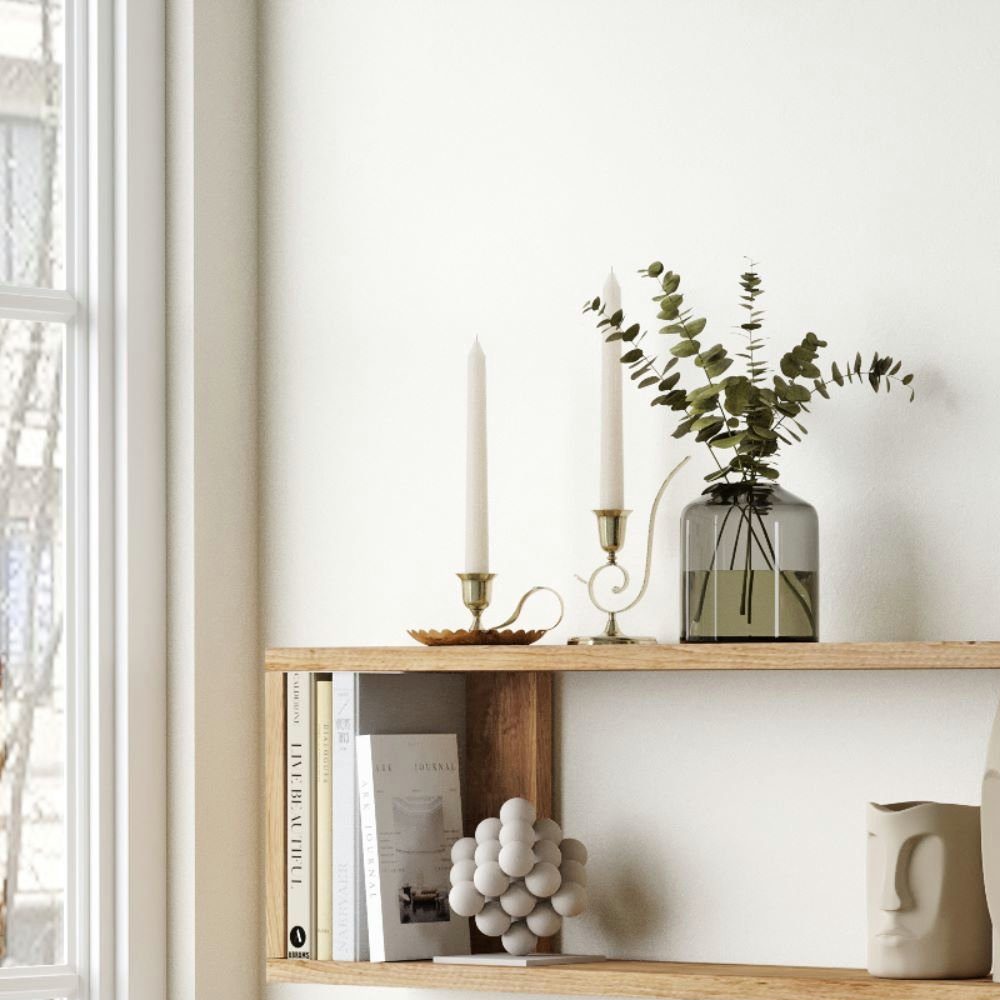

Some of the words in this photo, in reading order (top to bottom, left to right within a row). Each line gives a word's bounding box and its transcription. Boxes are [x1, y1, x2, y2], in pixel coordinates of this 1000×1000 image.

[291, 743, 302, 784] LIVE
[291, 788, 302, 889] BEAUTIFUL
[364, 823, 377, 899] JOURNAL
